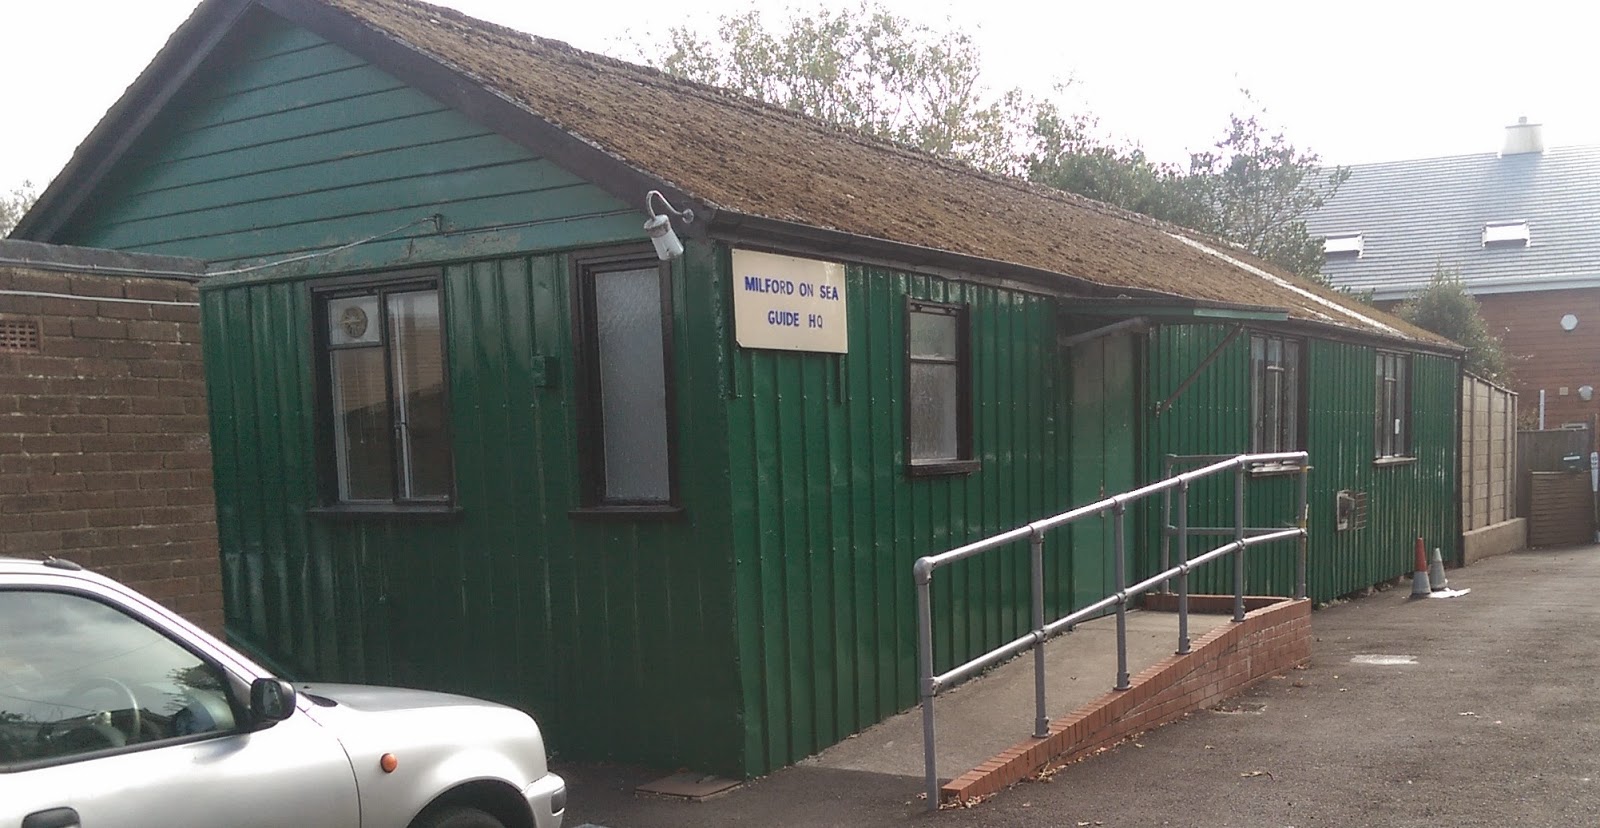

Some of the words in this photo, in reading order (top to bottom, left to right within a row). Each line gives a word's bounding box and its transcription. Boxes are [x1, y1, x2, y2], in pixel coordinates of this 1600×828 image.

[745, 276, 794, 295] MILFORD
[799, 283, 814, 297] ON
[820, 285, 839, 301] SEA
[768, 310, 800, 327] GUIDE
[808, 314, 823, 329] HQ
